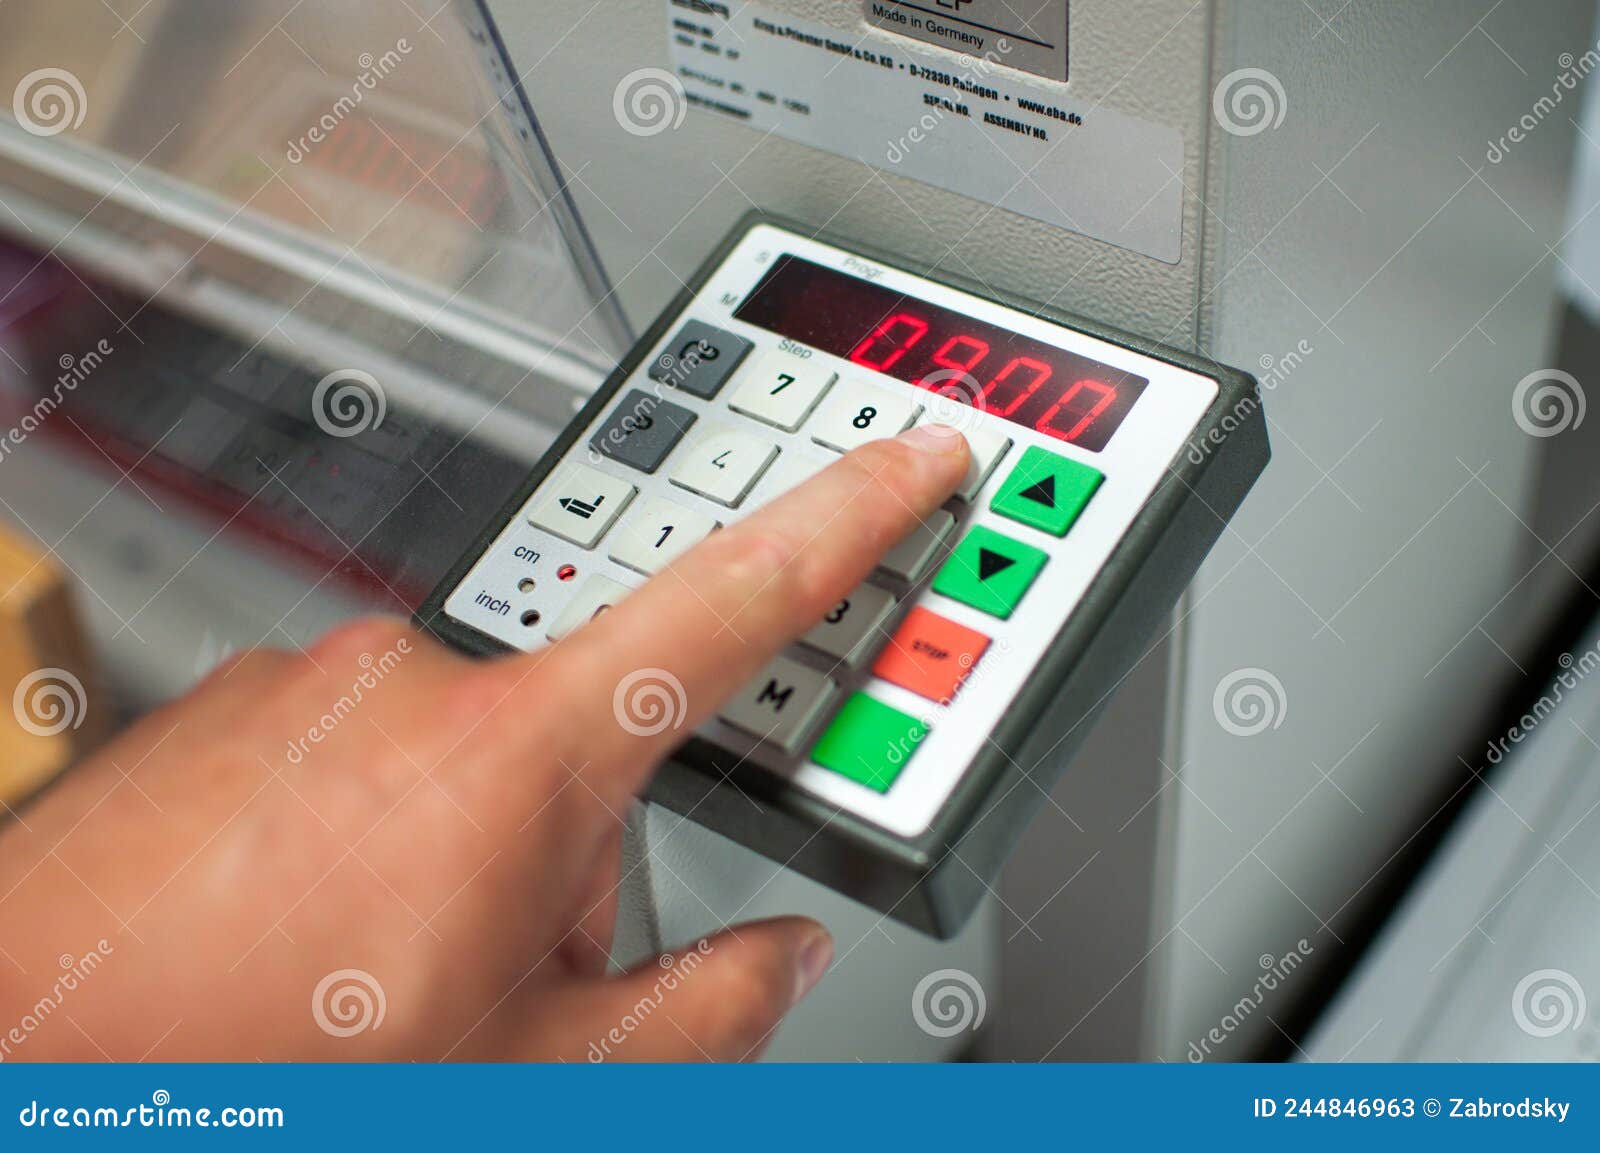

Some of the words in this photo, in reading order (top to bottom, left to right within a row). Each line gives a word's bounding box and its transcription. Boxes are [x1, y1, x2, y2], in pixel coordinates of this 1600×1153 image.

[872, 4, 906, 26] Made
[910, 14, 922, 29] in
[925, 20, 985, 50] Germany
[1017, 98, 1082, 126] www.eba.de
[983, 112, 1031, 137] ASSEMBLY
[1032, 127, 1049, 142] NO.
[778, 338, 814, 362] Step
[770, 374, 795, 396] 7
[853, 406, 877, 430] 8
[655, 525, 674, 548] 1
[514, 545, 540, 565] cm
[474, 590, 511, 617] inch
[757, 679, 796, 712] M
